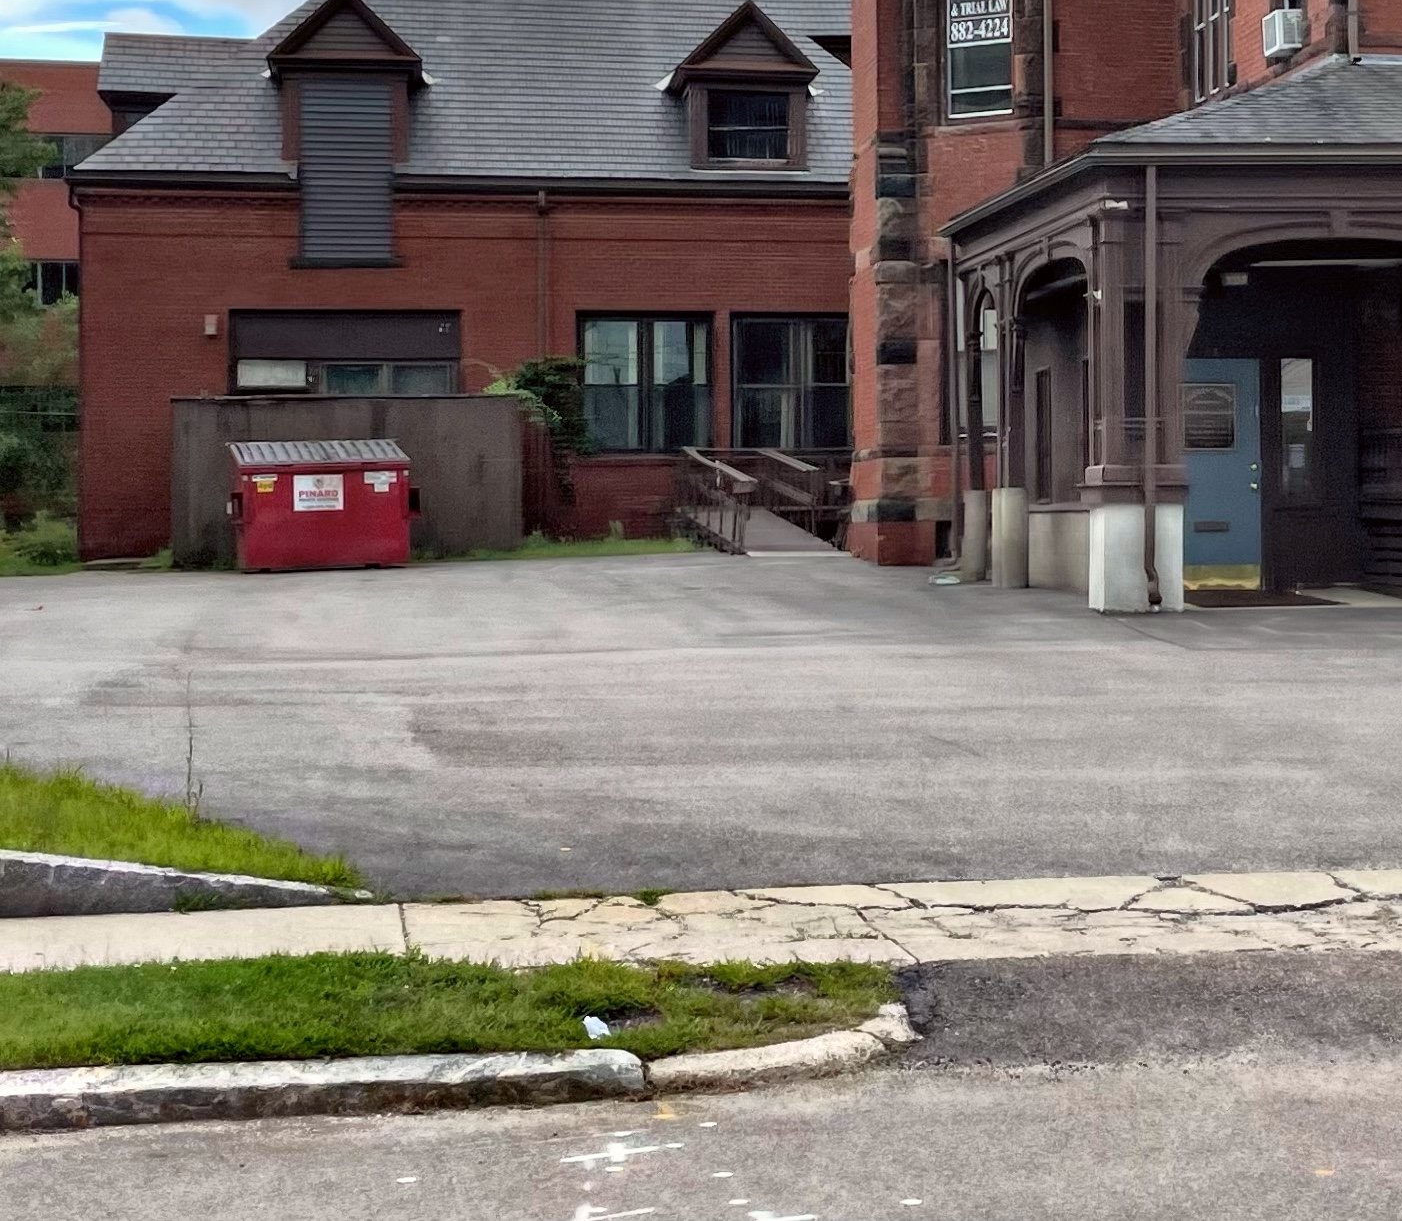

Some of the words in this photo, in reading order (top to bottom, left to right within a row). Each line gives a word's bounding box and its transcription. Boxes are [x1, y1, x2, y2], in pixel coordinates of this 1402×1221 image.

[951, 3, 958, 17] &
[960, 0, 987, 16] TRIAL
[951, 17, 1008, 41] 882-4224
[298, 489, 339, 498] PINARD
